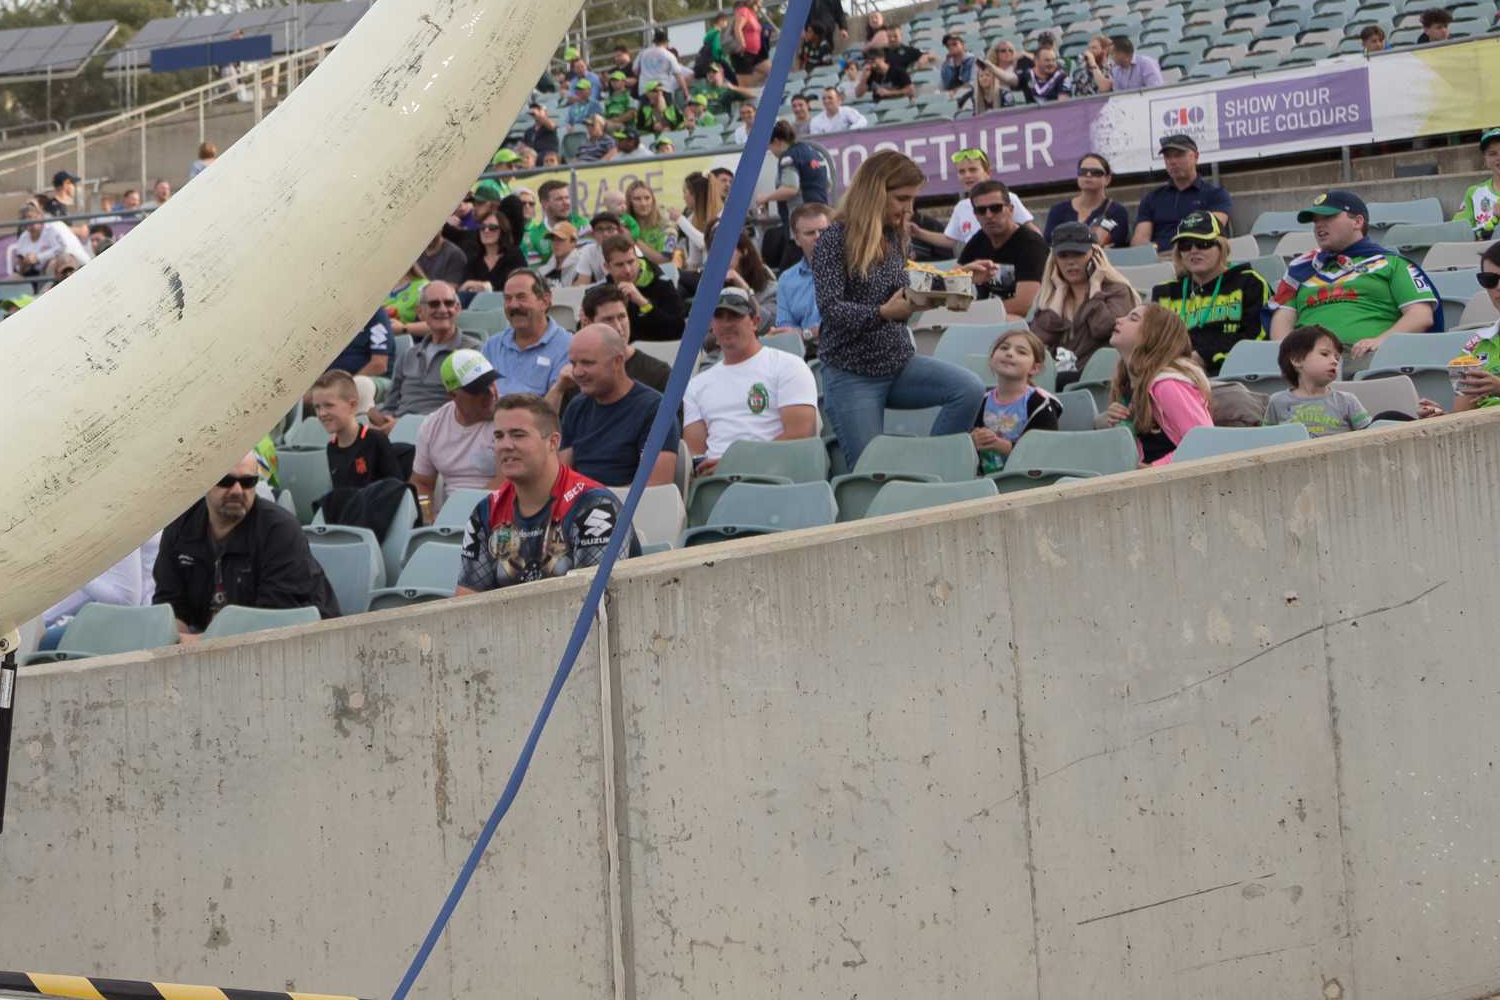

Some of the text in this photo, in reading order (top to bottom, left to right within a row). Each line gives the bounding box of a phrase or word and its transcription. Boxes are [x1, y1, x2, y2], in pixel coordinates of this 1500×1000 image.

[1163, 106, 1205, 128] GIO
[1225, 87, 1331, 118] SHOW YOUR
[1225, 103, 1360, 138] TRUE COLOURS
[826, 120, 1055, 187] OETER
[580, 536, 611, 547] SUZUK
